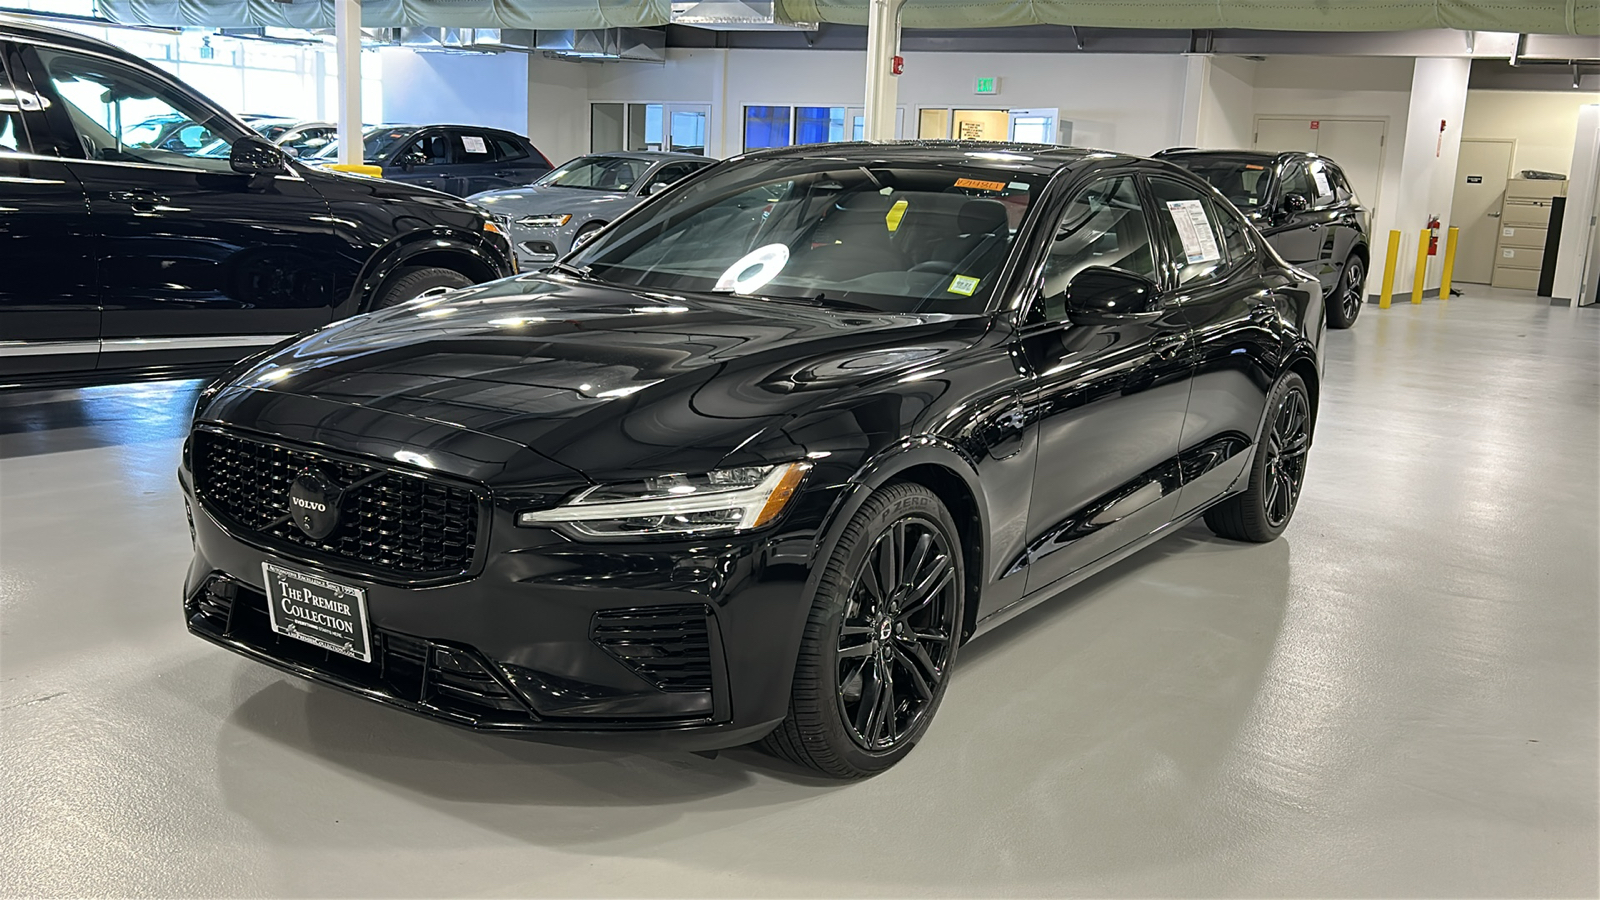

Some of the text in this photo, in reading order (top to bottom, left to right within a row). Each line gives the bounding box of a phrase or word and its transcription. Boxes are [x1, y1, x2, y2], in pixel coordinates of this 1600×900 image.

[977, 78, 993, 92] EXIT
[292, 496, 326, 512] VOLVO
[881, 508, 891, 523] P
[894, 497, 929, 514] ZERO
[278, 580, 352, 617] THE PREMIER
[281, 598, 354, 635] COLLECTION
